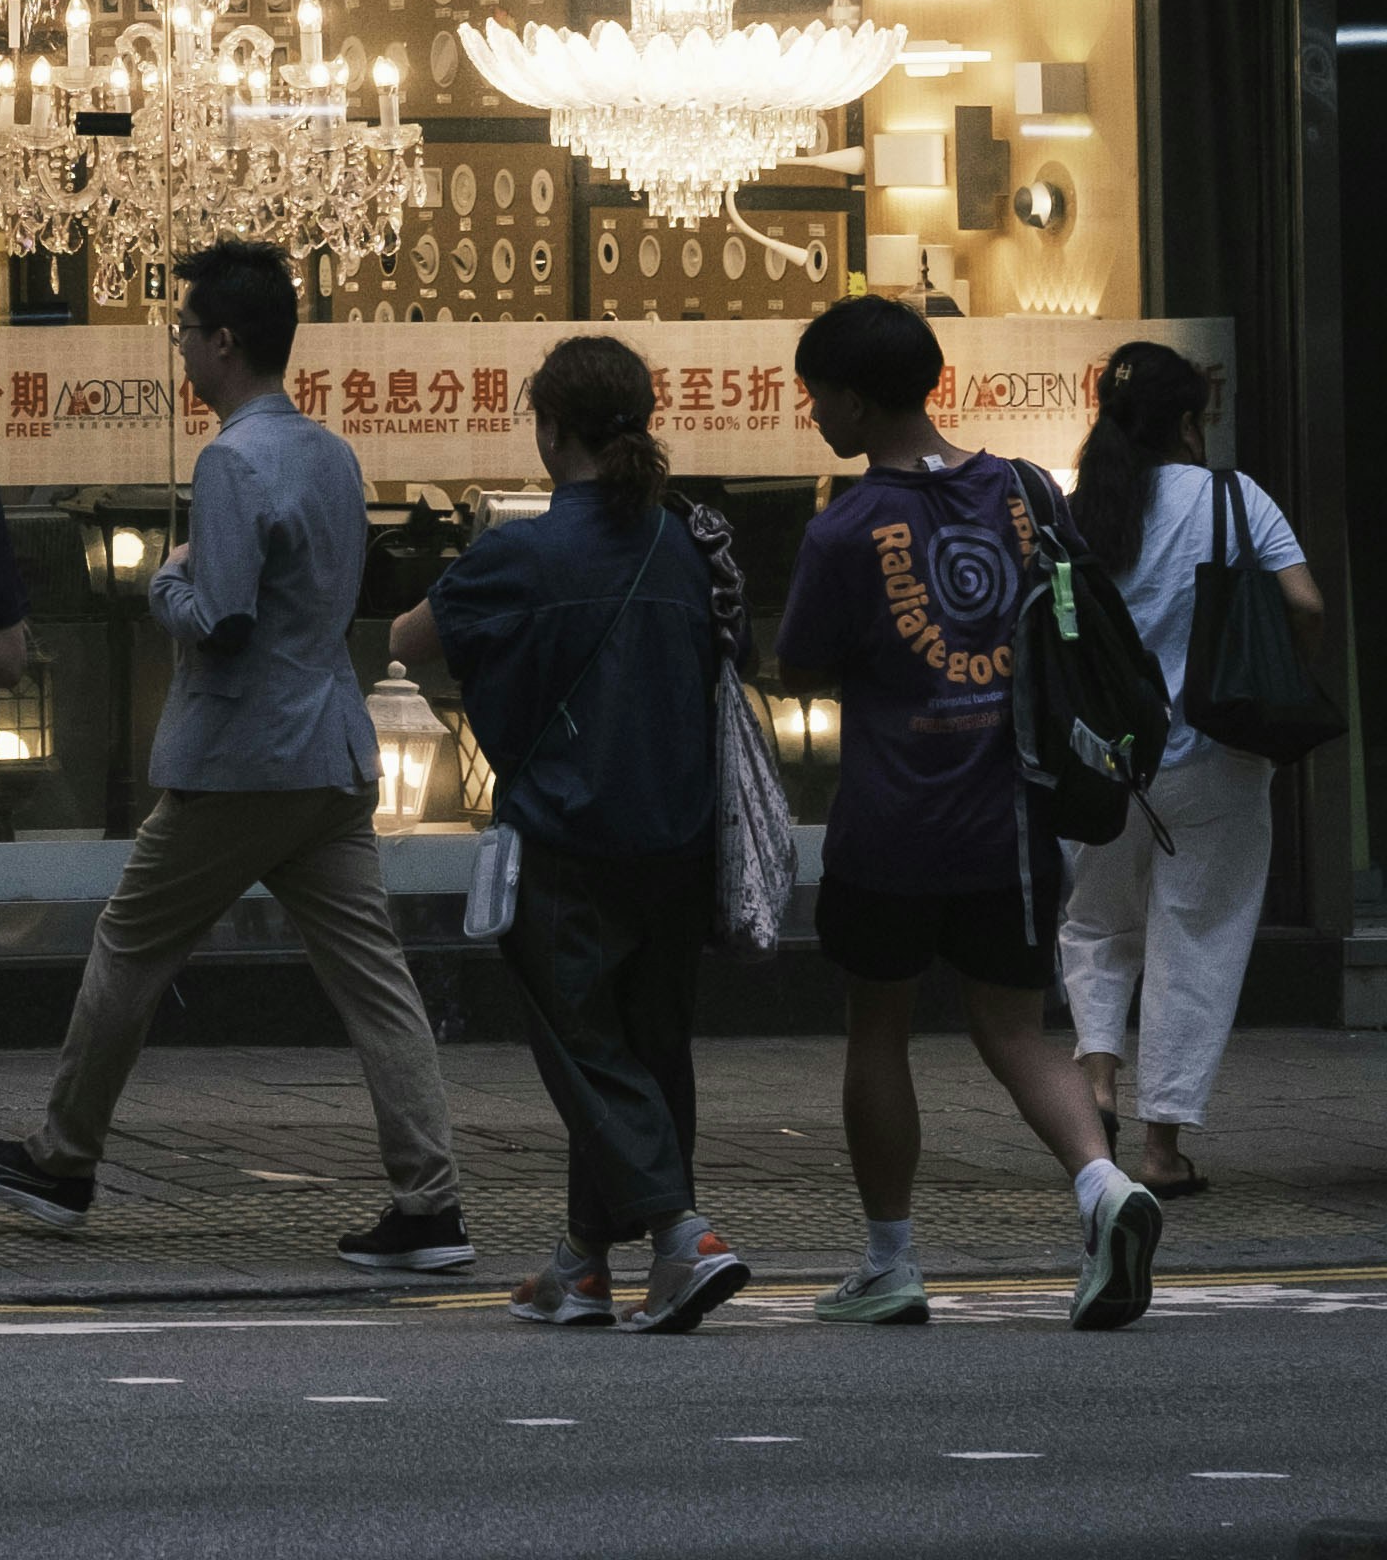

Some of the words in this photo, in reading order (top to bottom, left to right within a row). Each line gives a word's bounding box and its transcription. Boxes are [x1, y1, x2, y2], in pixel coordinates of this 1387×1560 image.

[5, 423, 52, 438] FREE
[185, 421, 210, 436] UP
[342, 417, 462, 434] INSTALMENT
[466, 417, 512, 433] FREE
[672, 416, 697, 431] TO
[703, 416, 741, 431] 50%
[746, 416, 781, 431] OFF
